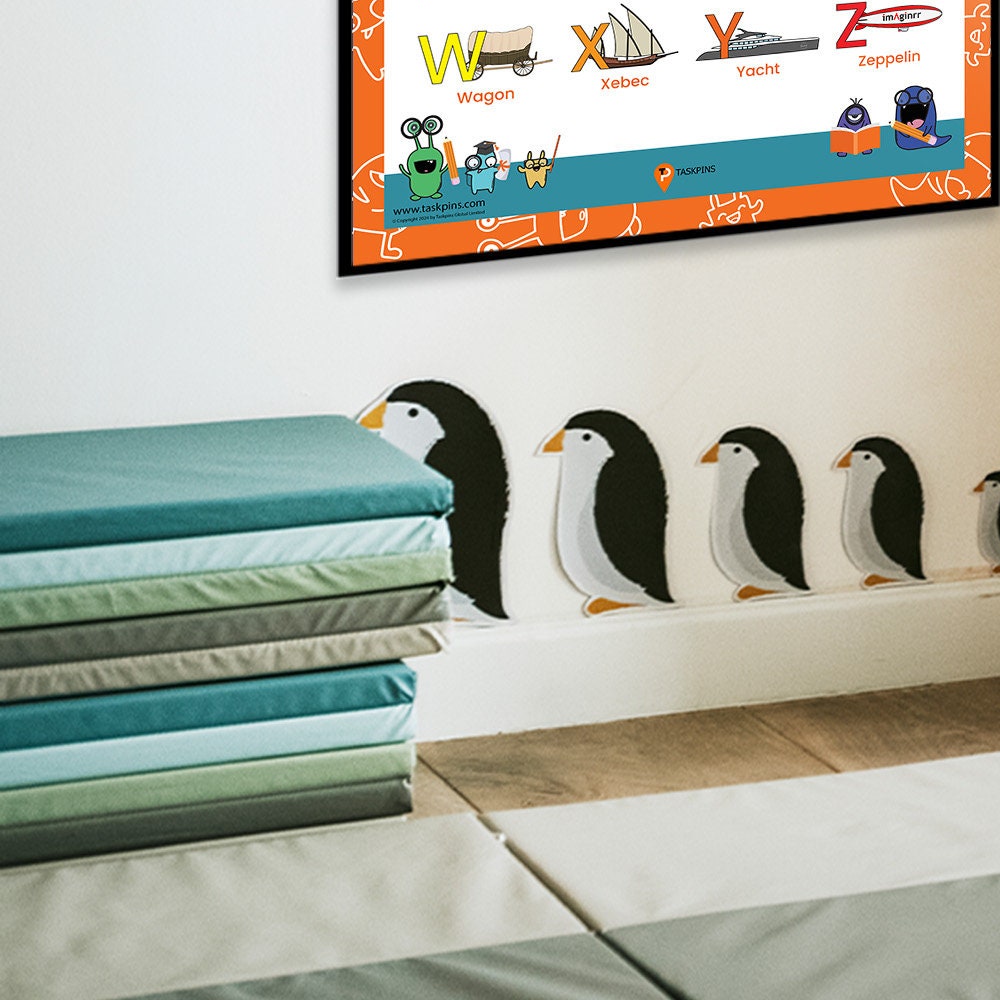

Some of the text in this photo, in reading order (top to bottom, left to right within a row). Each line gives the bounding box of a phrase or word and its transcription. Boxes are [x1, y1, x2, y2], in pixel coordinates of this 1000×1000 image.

[835, 1, 867, 50] Z
[704, 11, 745, 60] Y
[571, 22, 611, 73] X
[418, 30, 488, 85] W
[858, 50, 921, 69] Zeppelin
[736, 62, 781, 78] Yacht
[600, 75, 650, 90] Xebec
[456, 89, 515, 106] Wagon
[675, 164, 717, 177] TASKPINS
[392, 199, 486, 215] www.taskpins.com
